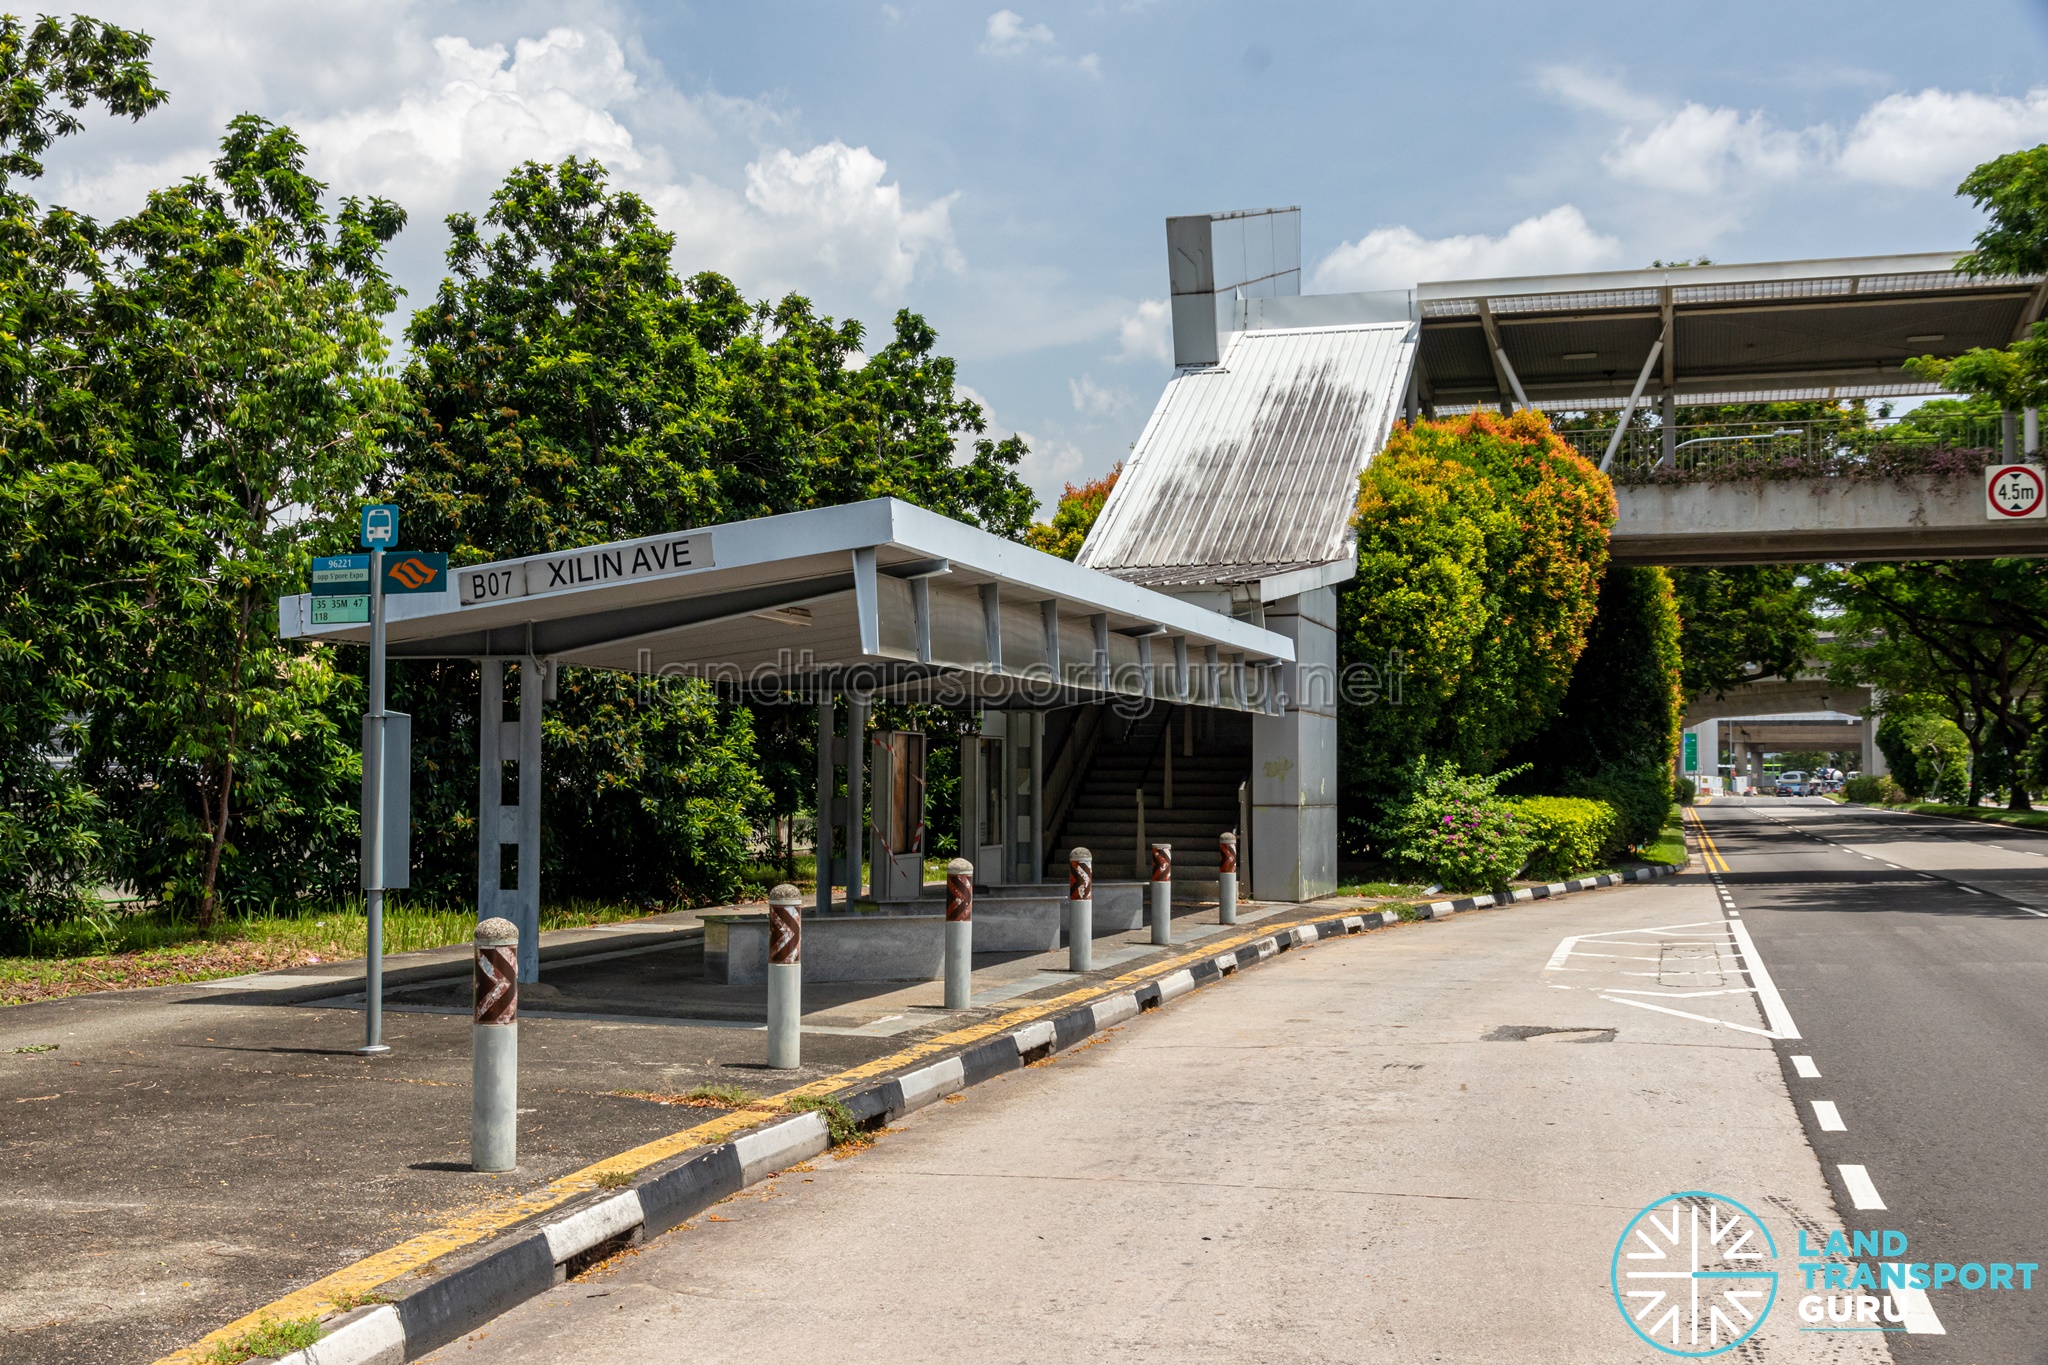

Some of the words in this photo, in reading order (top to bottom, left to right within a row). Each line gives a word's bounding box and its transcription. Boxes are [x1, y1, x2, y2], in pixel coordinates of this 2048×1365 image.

[1998, 483, 2034, 500] 4.5m
[328, 559, 351, 569] 96221
[472, 571, 512, 599] B07
[547, 551, 623, 588] XILIN
[631, 540, 692, 575] AVE
[330, 572, 348, 581] S'pore
[350, 571, 364, 580] Expo
[316, 600, 326, 609] 35
[332, 599, 348, 609] 35M
[353, 599, 363, 608] 47
[314, 612, 328, 621] 118
